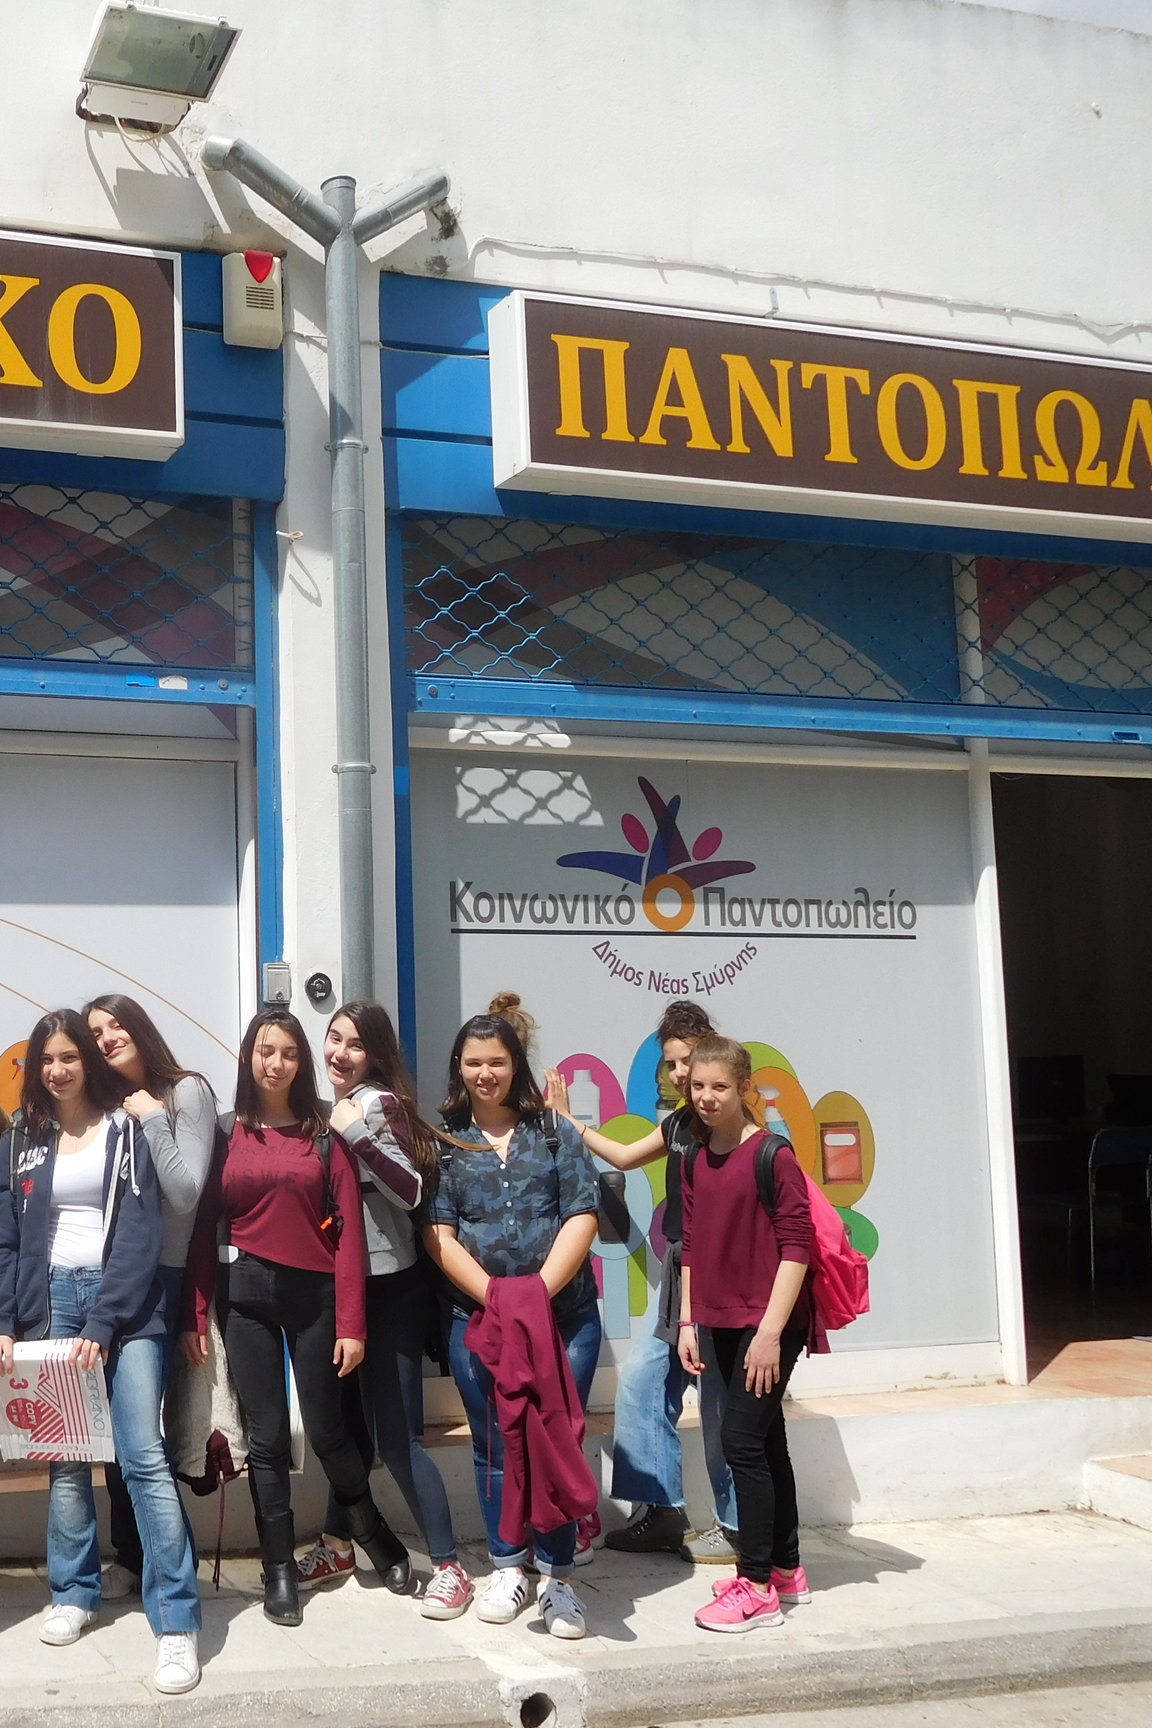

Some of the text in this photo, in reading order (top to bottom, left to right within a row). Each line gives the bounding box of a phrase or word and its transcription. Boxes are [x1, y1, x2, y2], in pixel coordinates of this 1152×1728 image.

[449, 881, 917, 930] Κοινωνικό Παντοπωλείο
[592, 940, 758, 996] Δήμος Νέας Σμύρνης
[9, 1377, 29, 1390] 3
[25, 1402, 38, 1426] COPY
